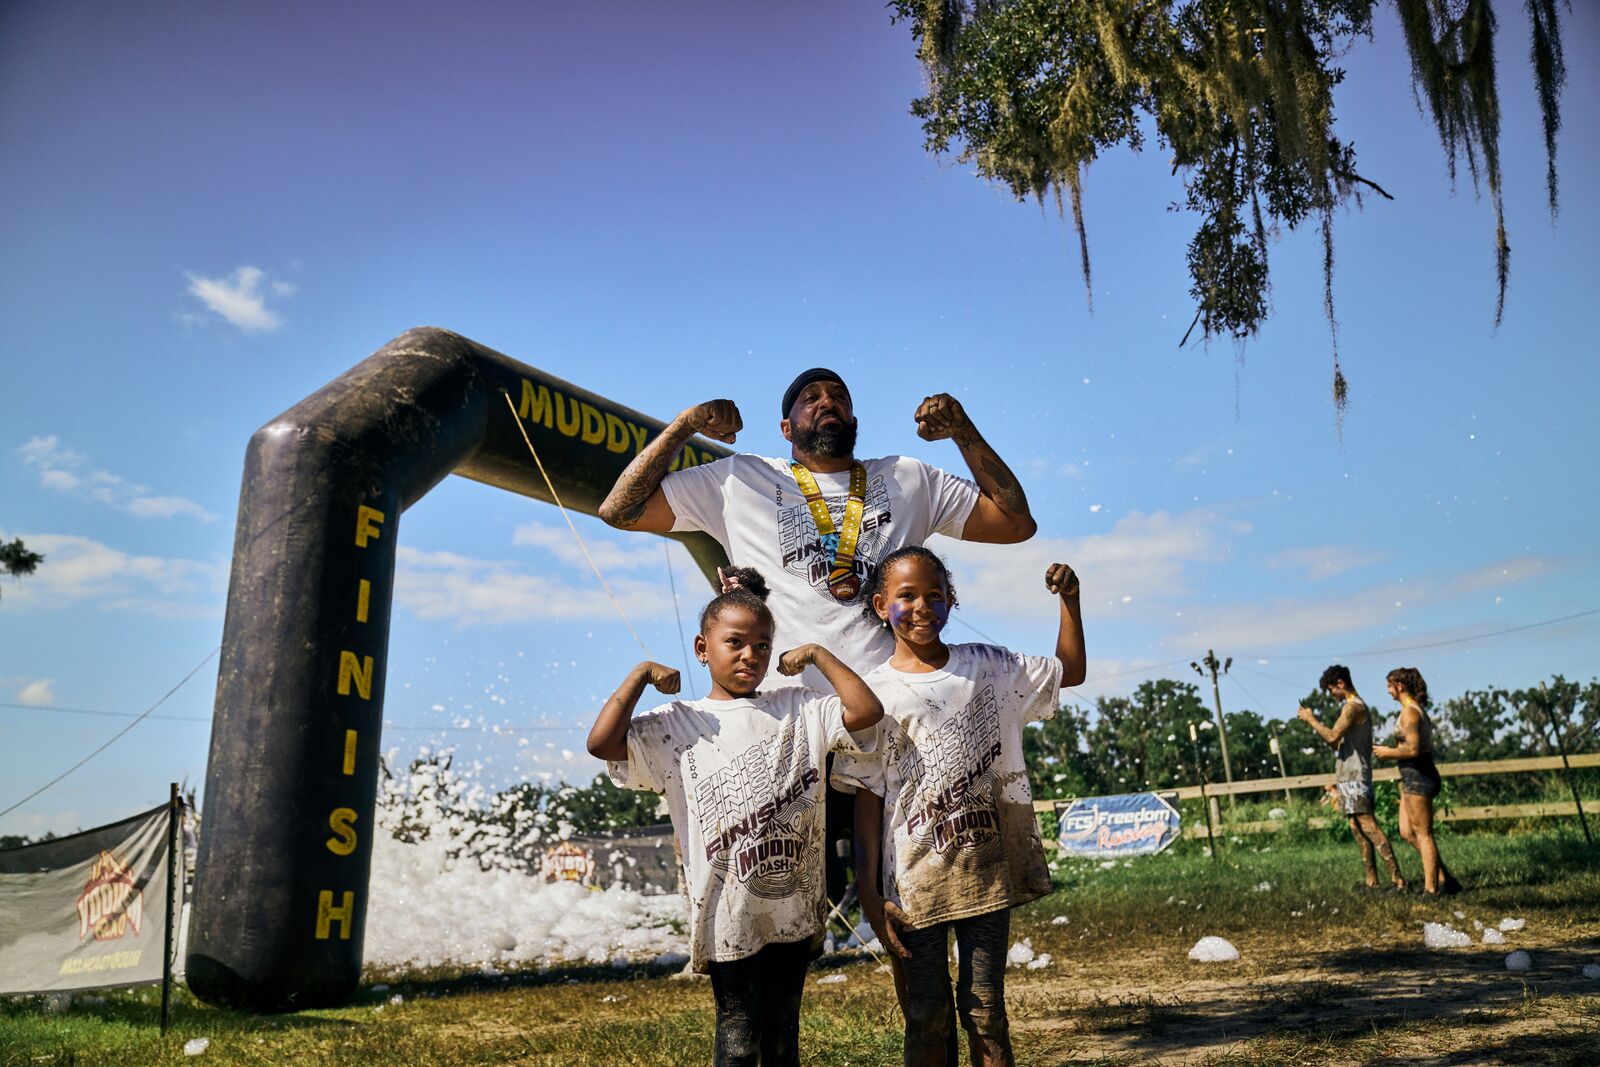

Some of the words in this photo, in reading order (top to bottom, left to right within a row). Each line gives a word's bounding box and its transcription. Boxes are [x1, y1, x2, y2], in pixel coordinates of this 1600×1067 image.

[518, 378, 648, 455] MUDDY
[783, 510, 892, 568] FINER
[315, 505, 384, 939] FINISH
[907, 741, 1002, 835] FINISHER
[706, 767, 820, 862] FINISHER
[956, 830, 986, 846] DASH
[1066, 815, 1093, 831] FCS
[1098, 807, 1170, 826] Freedom
[1096, 819, 1169, 850] Racing
[738, 838, 803, 875] MUDDY
[759, 857, 790, 875] DASH
